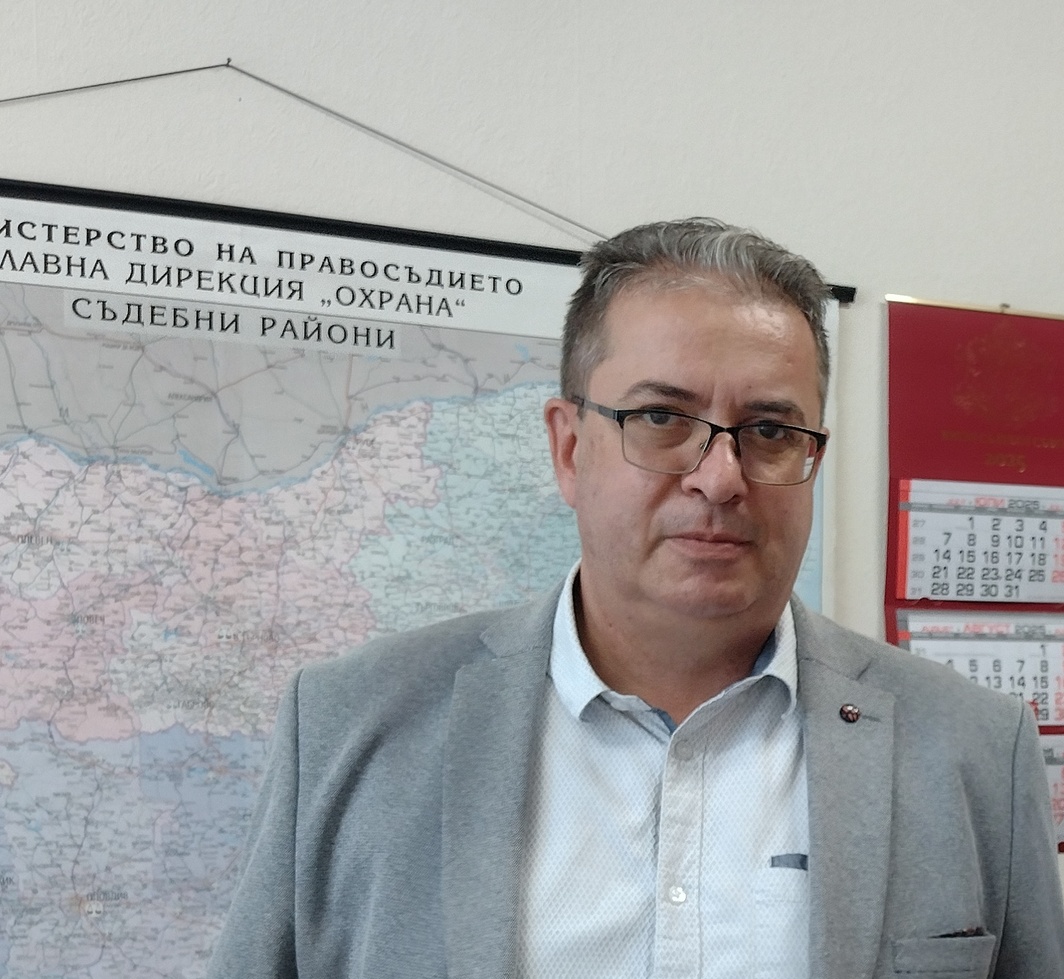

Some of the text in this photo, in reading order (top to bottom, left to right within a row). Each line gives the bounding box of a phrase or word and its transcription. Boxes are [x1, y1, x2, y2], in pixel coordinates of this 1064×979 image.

[216, 243, 257, 265] НА
[277, 250, 523, 296] ПРАВОСЪДИЕТО
[0, 249, 466, 317] ЛАВНА ДИРЕКЦИЯ „ОХРАНА“
[72, 298, 395, 349] СЪДЕБНИ РАЙОНИ
[1007, 499, 1040, 510] 2025
[968, 516, 975, 530] 1
[991, 518, 1001, 531] 2
[1015, 519, 1024, 532] 3
[1039, 520, 1048, 533] 4
[943, 532, 952, 545] 7
[967, 533, 977, 547] 8
[991, 534, 1000, 547] 9
[1007, 535, 1024, 548] 10
[1031, 536, 1046, 550] 11
[933, 548, 951, 562] 14
[959, 549, 976, 563] 15
[983, 550, 1000, 564] 16
[1007, 551, 1023, 565] 17
[1030, 552, 1047, 566] 18
[932, 566, 949, 579] 21
[956, 566, 976, 580] 22
[981, 567, 1000, 581] 23
[1005, 568, 1023, 581] 24
[1028, 569, 1045, 582] 25
[931, 582, 950, 596] 28
[956, 583, 974, 596] 29
[980, 584, 999, 597] 30
[1004, 585, 1020, 598] 31
[1040, 644, 1046, 657] 1
[968, 659, 978, 672] 5
[993, 659, 1002, 672] 6
[1016, 660, 1025, 673] 7
[1040, 660, 1049, 673] 8
[985, 675, 1002, 689] 13
[1009, 676, 1026, 689] 14
[1033, 676, 1049, 689] 15
[1032, 692, 1049, 705] 22
